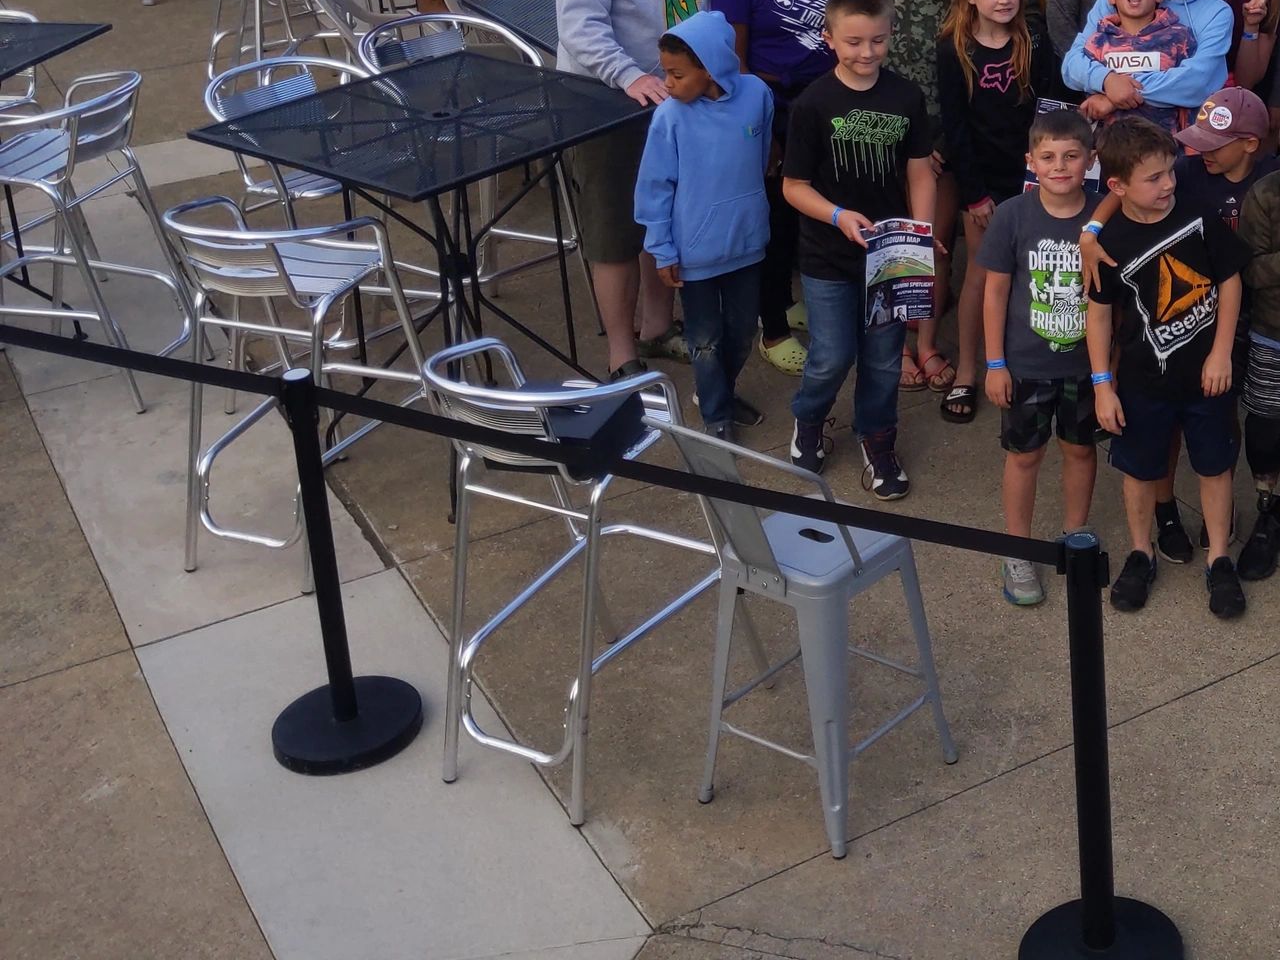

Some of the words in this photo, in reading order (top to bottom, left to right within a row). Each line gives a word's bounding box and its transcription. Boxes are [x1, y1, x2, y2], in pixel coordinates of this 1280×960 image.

[800, 8, 826, 27] LITTL
[1107, 55, 1153, 69] NASA
[1197, 101, 1216, 121] S
[881, 236, 906, 247] STADIUM
[907, 236, 921, 245] MAP
[909, 280, 934, 289] SPOTLIGHT
[1052, 299, 1080, 316] One
[1031, 309, 1087, 332] FRIENDSH
